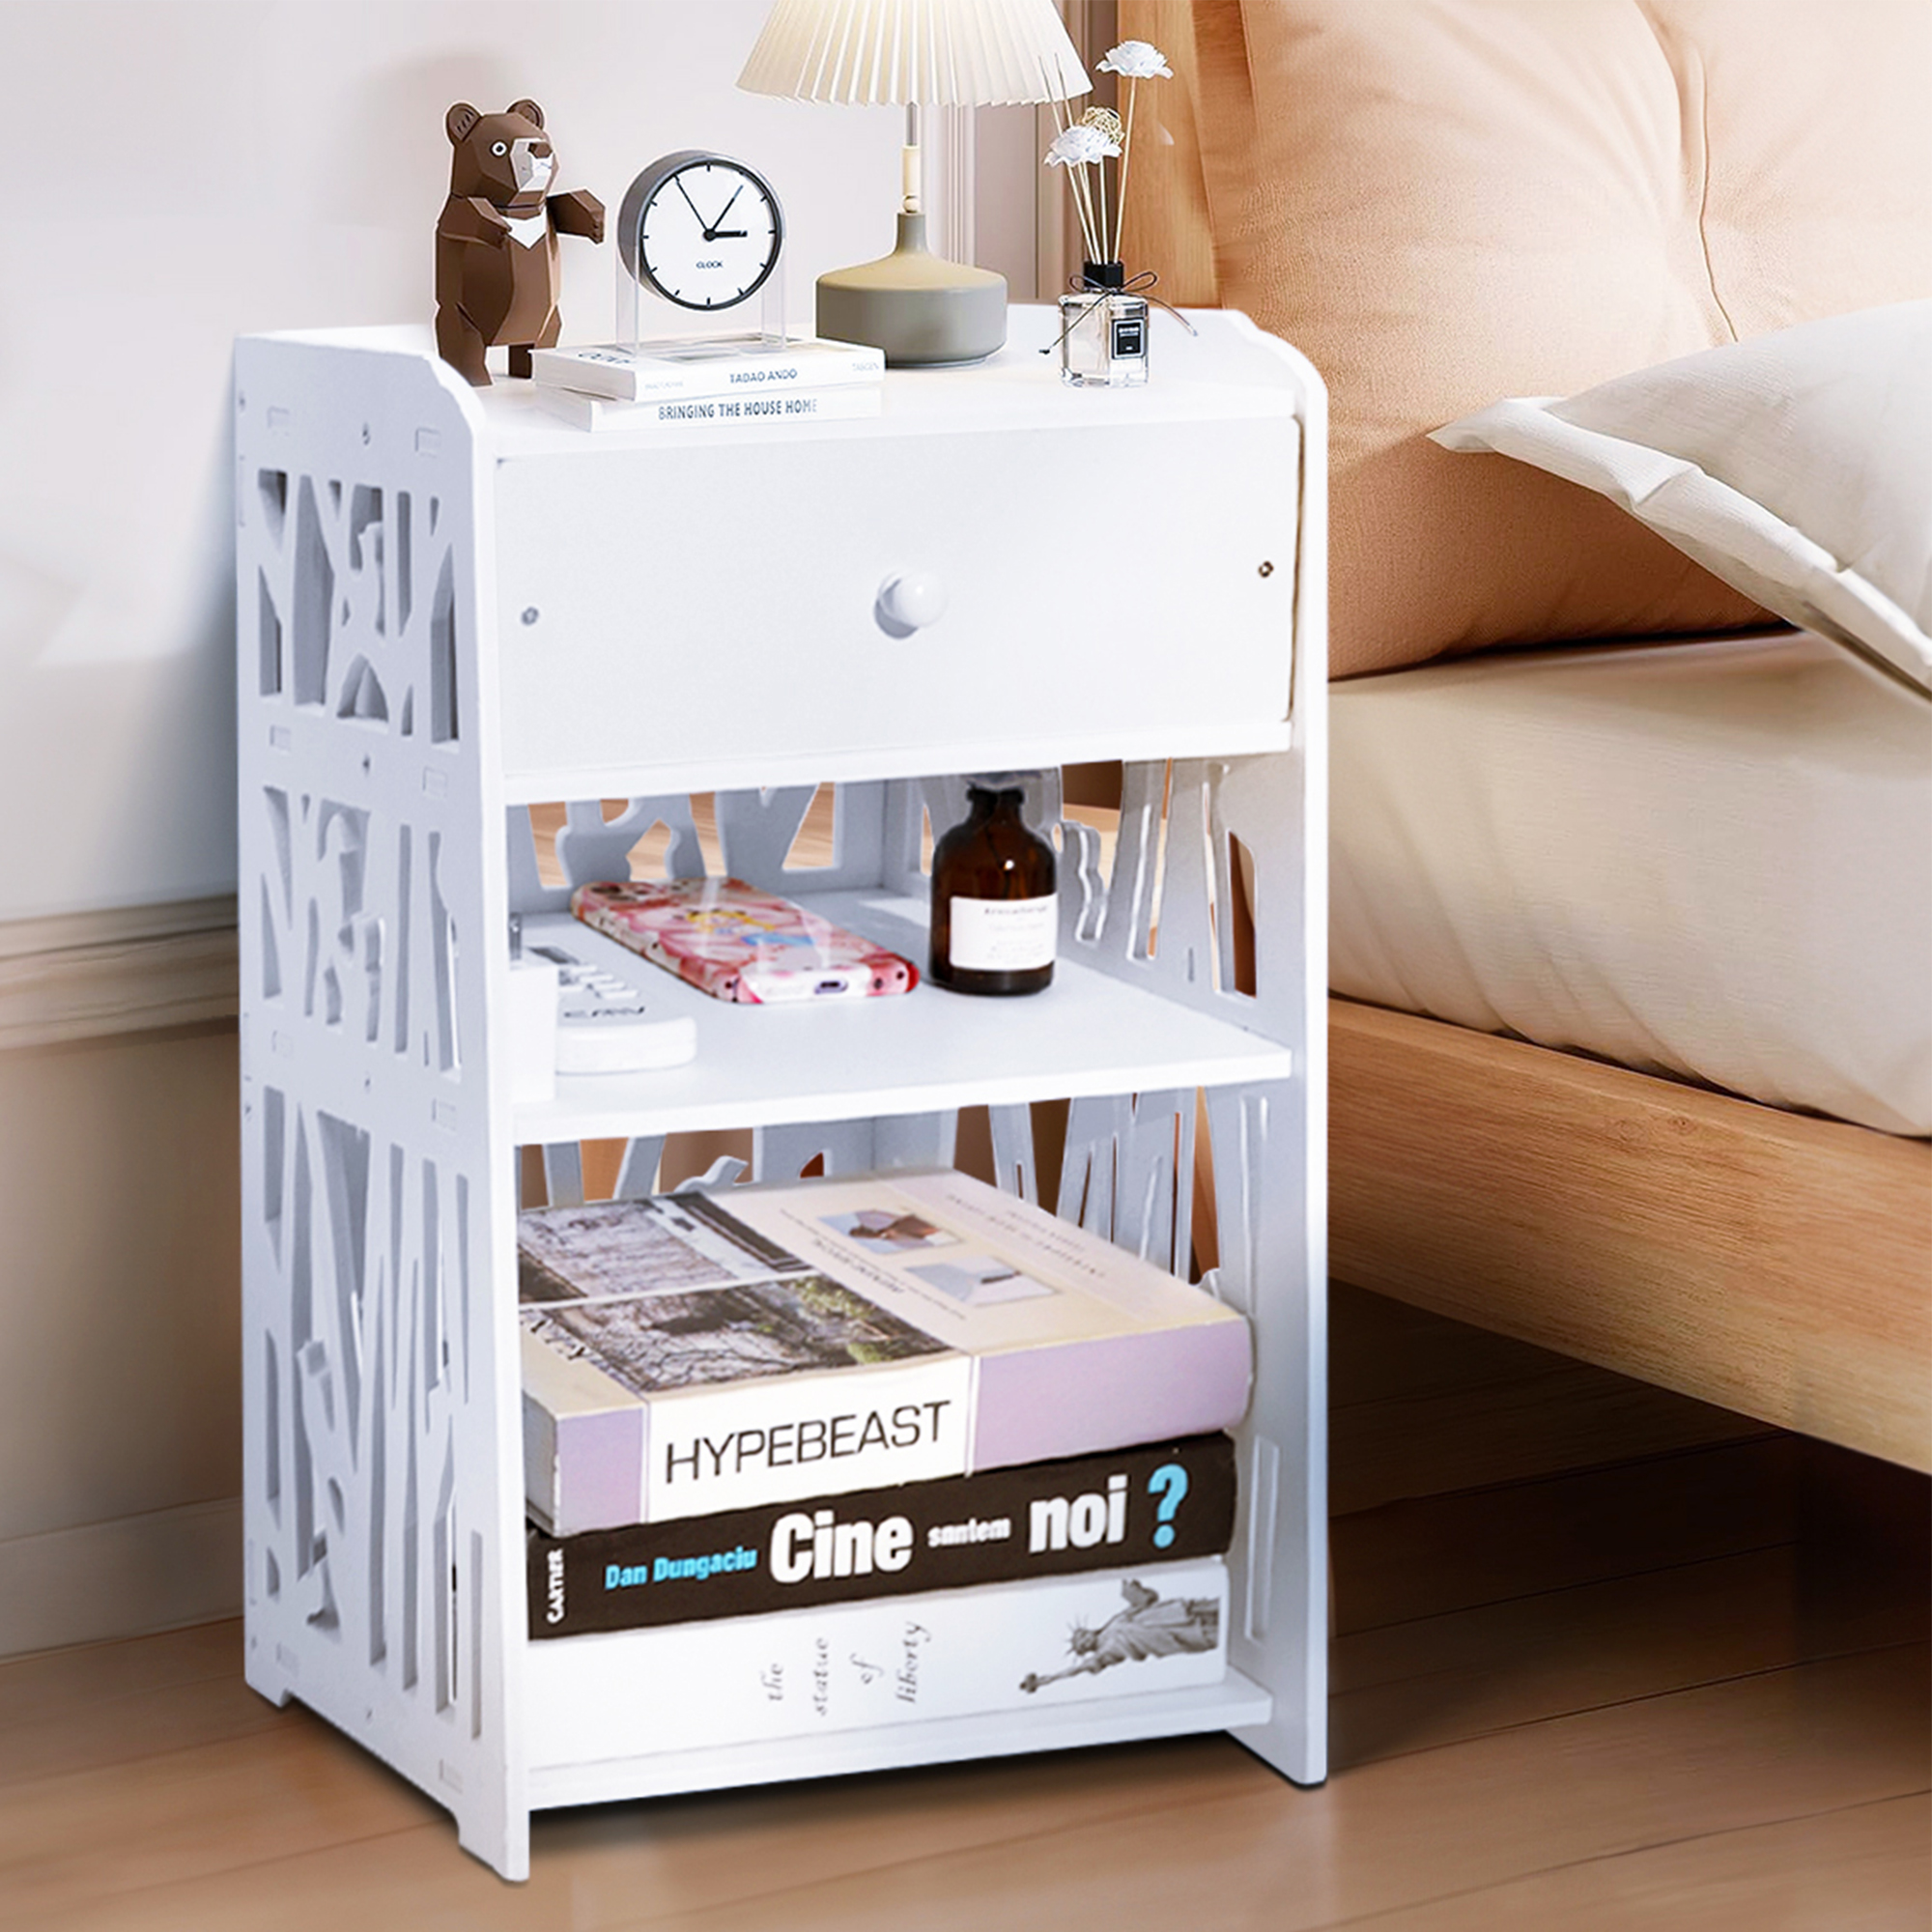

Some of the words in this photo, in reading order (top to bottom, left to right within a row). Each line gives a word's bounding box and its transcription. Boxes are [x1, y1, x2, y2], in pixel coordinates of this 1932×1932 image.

[696, 260, 724, 270] CLOCK
[729, 370, 766, 384] TADAO
[767, 368, 798, 382] ANDO
[658, 403, 715, 420] BRINGING
[719, 402, 741, 417] THE
[744, 400, 781, 416] HOUSE
[785, 398, 818, 413] HOME
[666, 1399, 952, 1485] HYPEBEAST
[770, 1510, 913, 1583] Cine
[1029, 1474, 1127, 1553] noi
[1148, 1463, 1188, 1548] ?
[605, 1564, 648, 1590] Dan
[653, 1545, 758, 1582] Dungaciu
[850, 1653, 884, 1685] of
[895, 1622, 932, 1703] liberty
[761, 1663, 783, 1701] the
